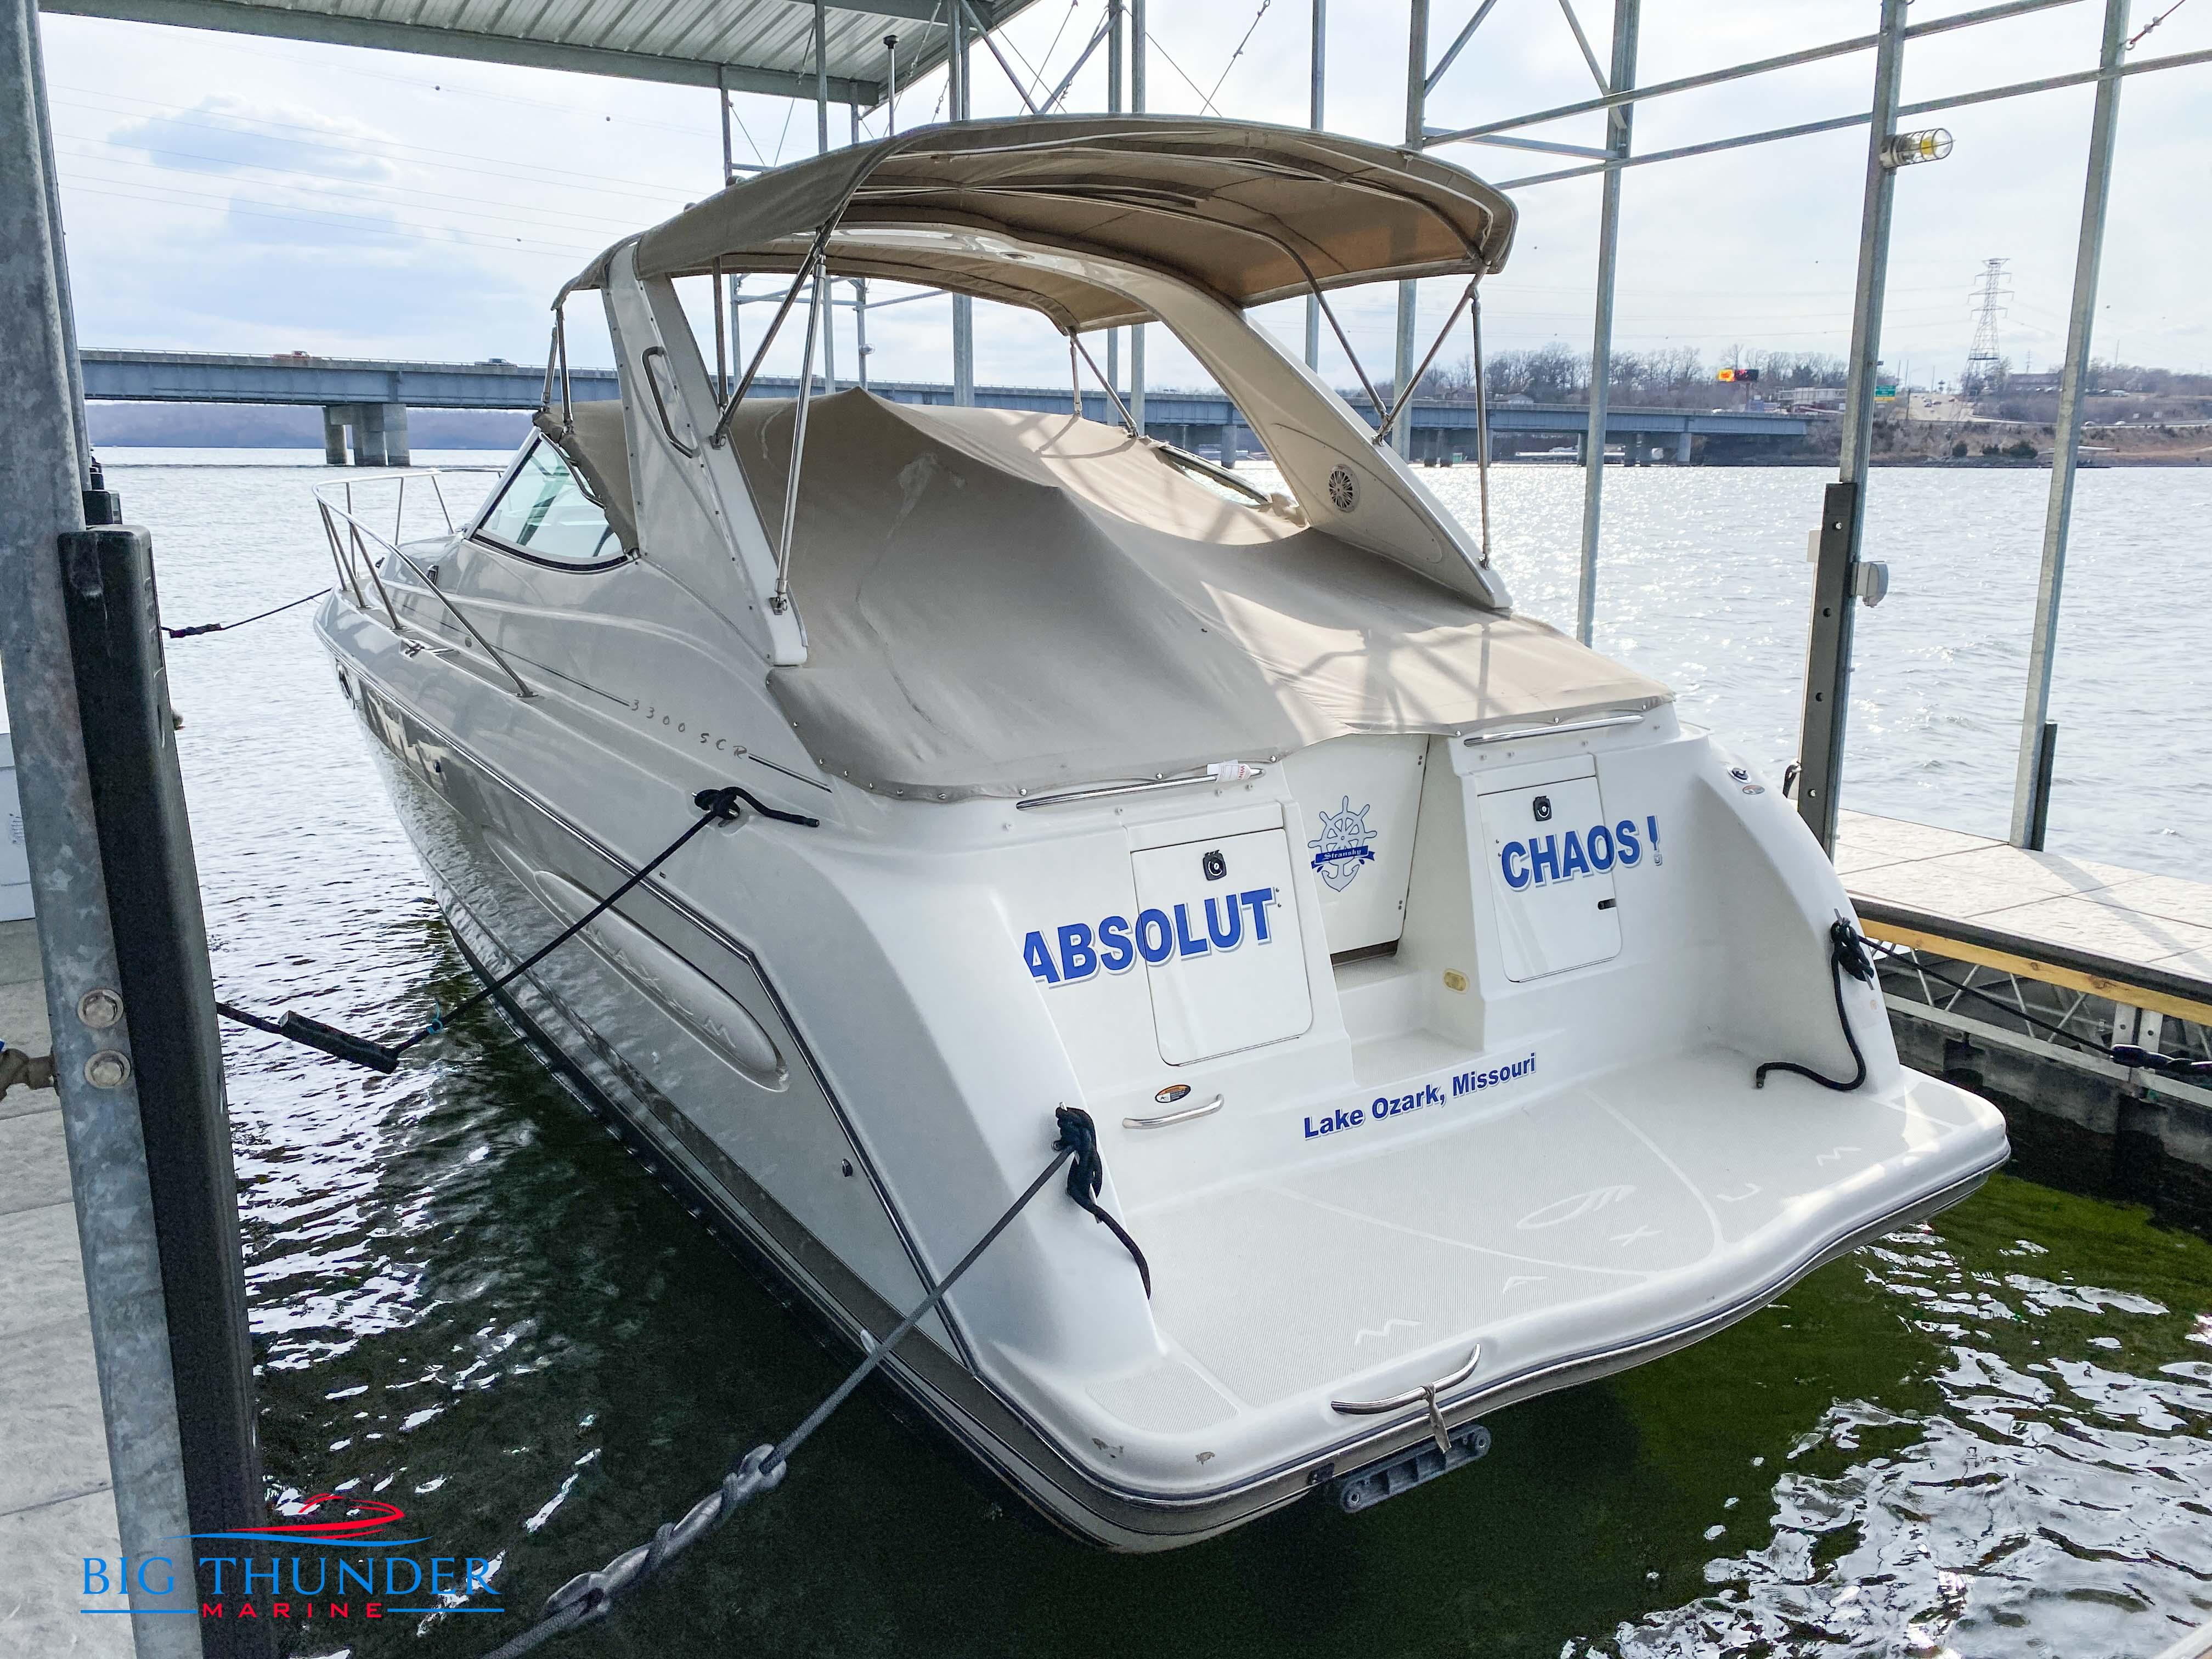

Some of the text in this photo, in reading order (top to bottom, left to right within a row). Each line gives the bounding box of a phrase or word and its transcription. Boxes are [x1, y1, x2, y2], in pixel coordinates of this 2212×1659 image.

[631, 699, 685, 732] 3300
[1024, 888, 1276, 990] ABSOLUT
[1304, 1052, 1536, 1141] Lake Ozark, Missouri
